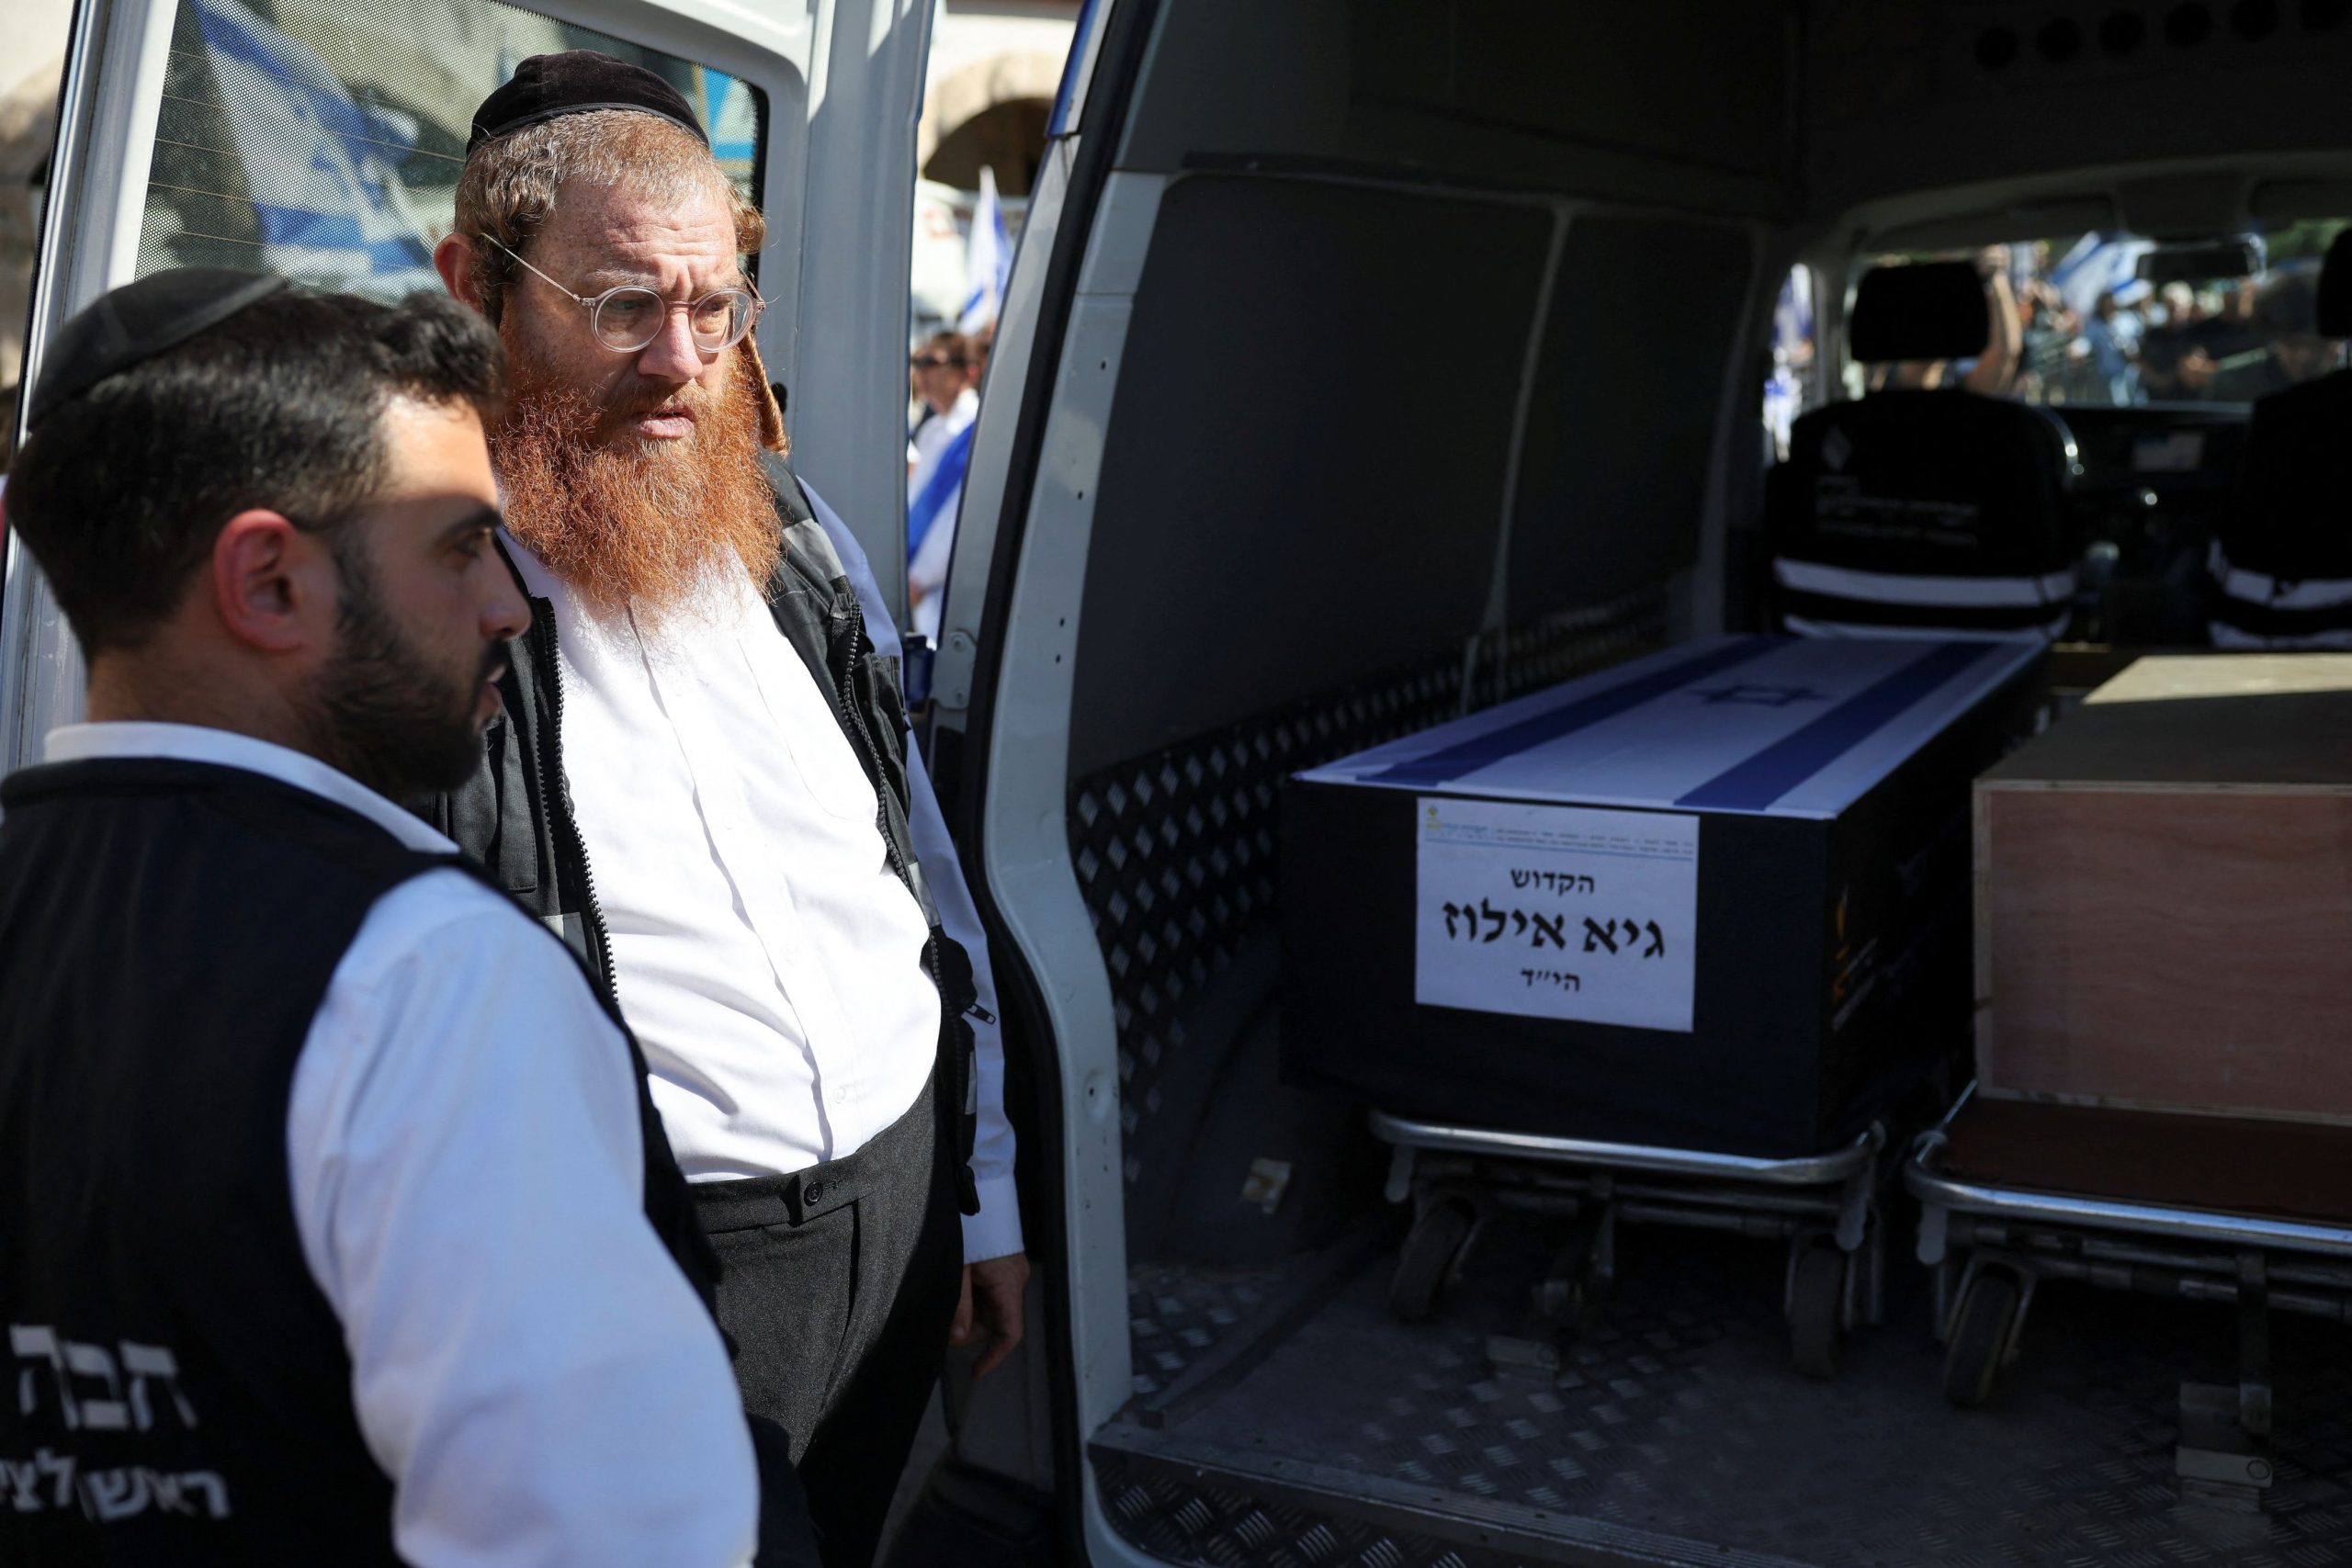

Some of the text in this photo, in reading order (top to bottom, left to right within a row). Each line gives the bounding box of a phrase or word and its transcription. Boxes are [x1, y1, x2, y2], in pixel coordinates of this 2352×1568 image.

[1510, 868, 1595, 897] הקדוש
[1442, 897, 1665, 959] גיא אילוז
